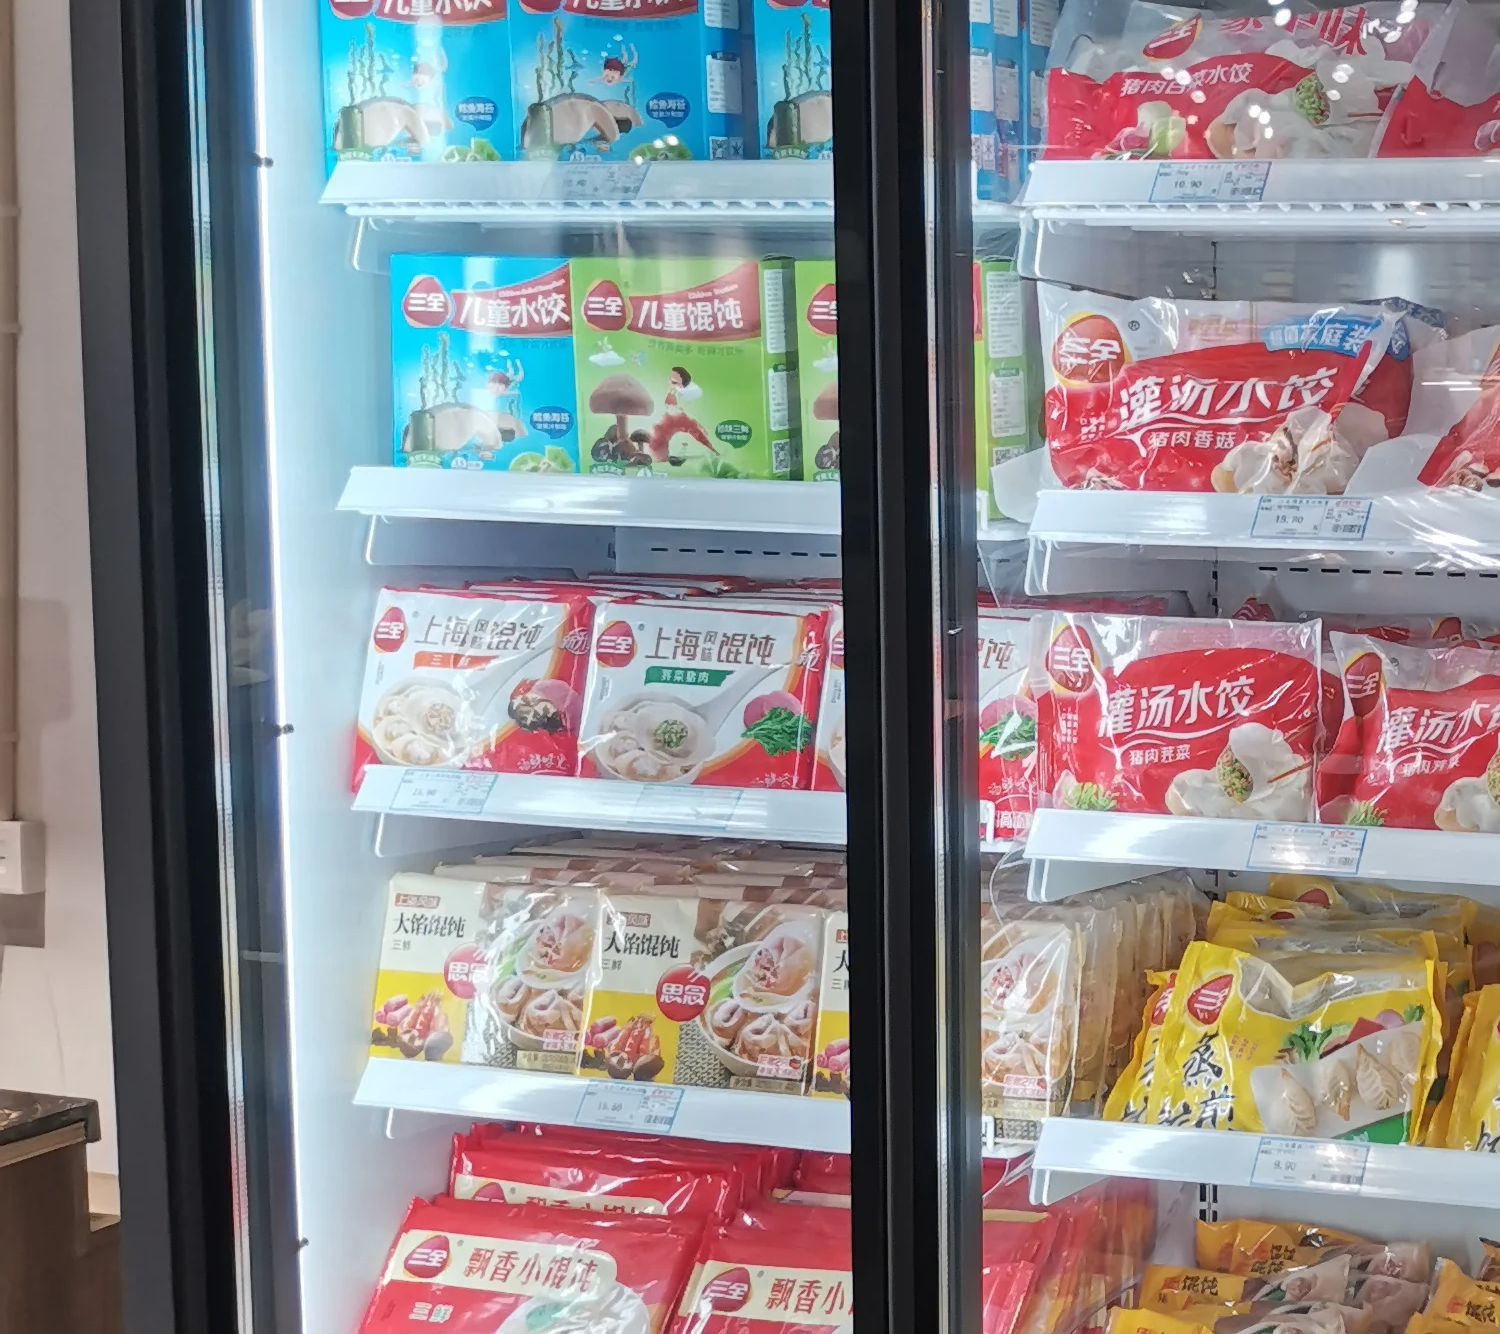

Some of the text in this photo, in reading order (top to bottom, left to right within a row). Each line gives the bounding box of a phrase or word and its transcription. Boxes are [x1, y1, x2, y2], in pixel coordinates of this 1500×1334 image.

[408, 293, 446, 313] 三全
[460, 292, 570, 329] 儿童水饺
[587, 296, 623, 317] 三全
[637, 298, 744, 332] 儿童馄饨
[1118, 366, 1339, 431] 灌汤水饺
[1150, 430, 1236, 451] 猪肉香菇
[597, 635, 633, 655] 三全
[1098, 674, 1255, 739] 灌汤水饺
[1129, 744, 1191, 766] 猪肉荠菜
[392, 911, 466, 939] 大馅馄饨
[604, 931, 681, 959] 大馅馄饨
[660, 982, 706, 1006] 思念
[407, 1247, 449, 1268] 三全
[464, 1247, 598, 1293] 飘香小馄饨
[764, 1277, 854, 1316] 飘香小
[408, 1301, 455, 1325] 三鲜
